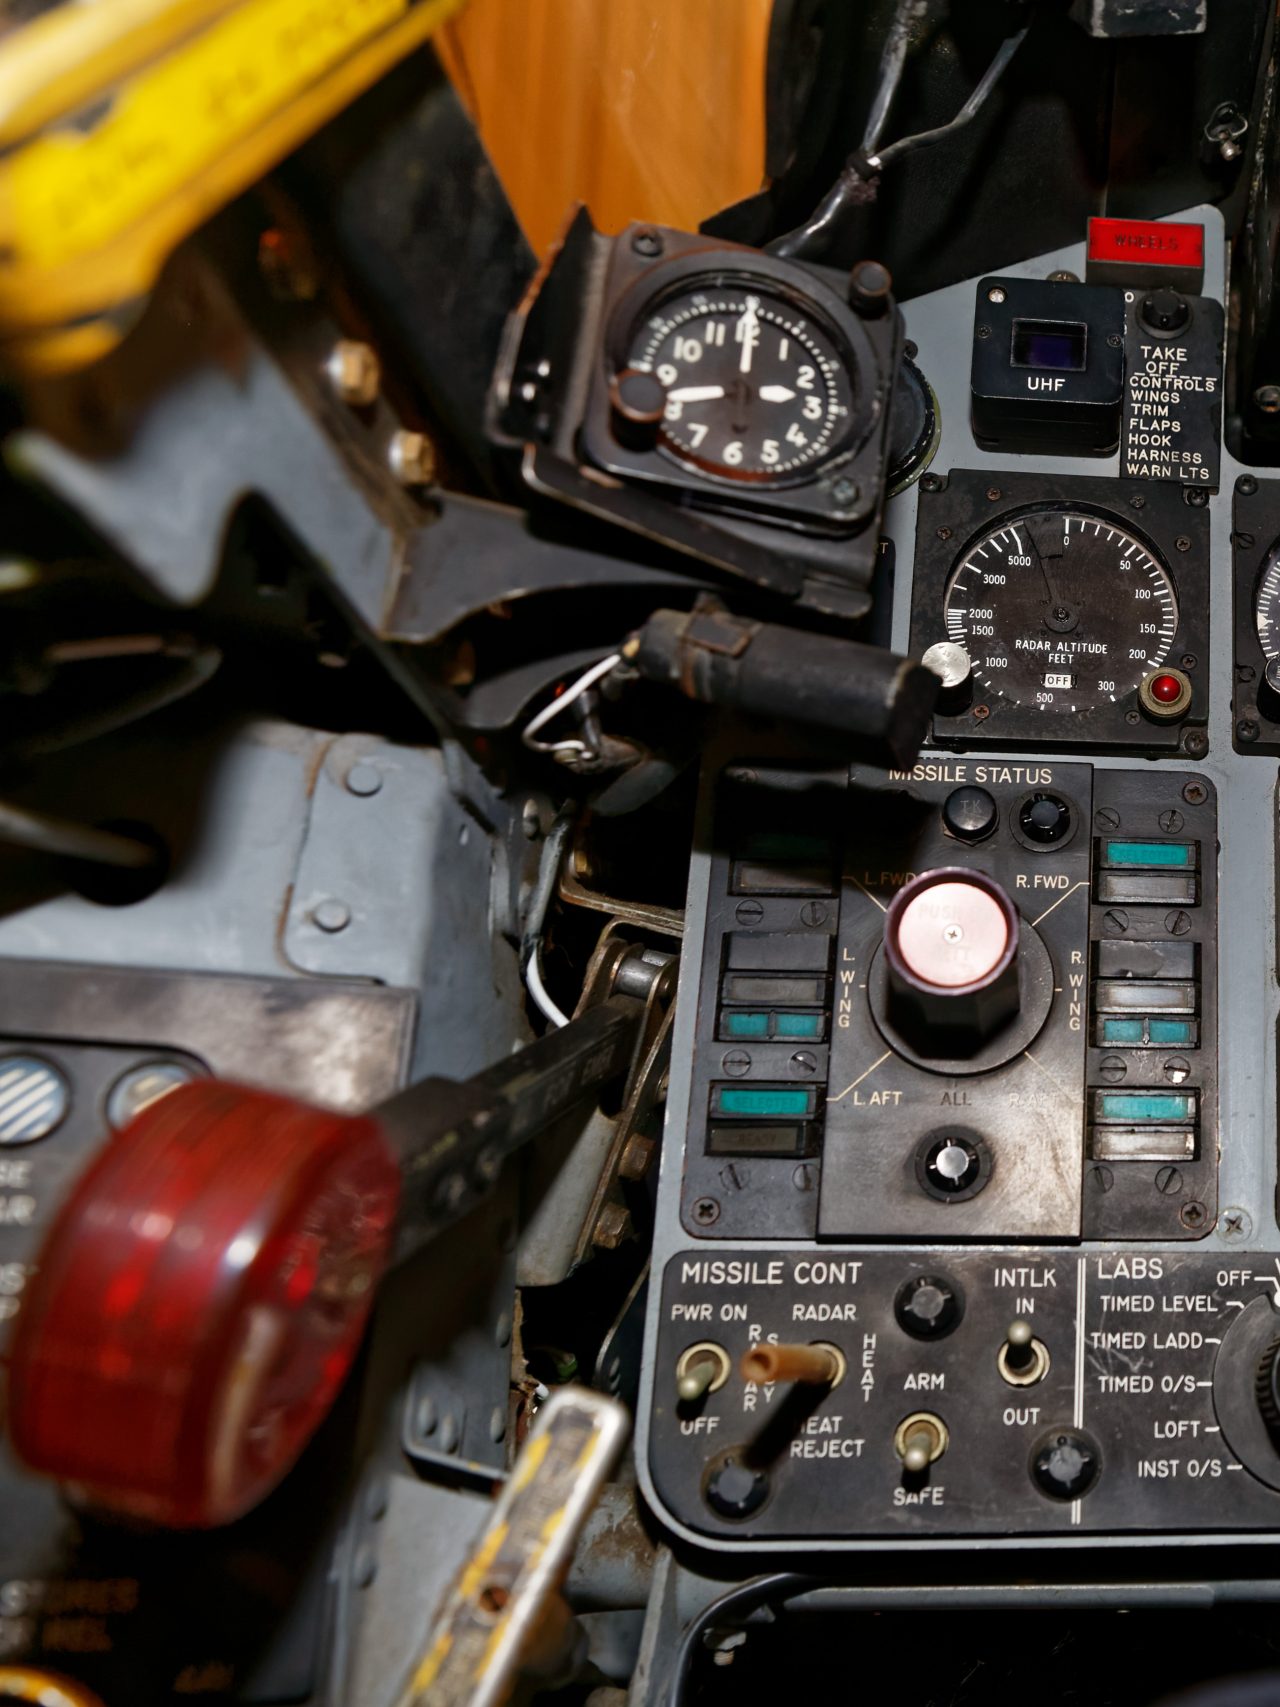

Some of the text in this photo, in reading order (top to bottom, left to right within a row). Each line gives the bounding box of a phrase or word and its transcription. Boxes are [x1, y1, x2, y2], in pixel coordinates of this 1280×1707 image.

[1114, 234, 1179, 251] WHEELS
[704, 320, 726, 347] 11
[673, 336, 703, 363] 10
[1140, 345, 1187, 362] TAKE
[1145, 361, 1180, 374] OFF
[796, 365, 815, 390] 2
[1027, 376, 1066, 392] UHF
[1129, 376, 1215, 392] CONTROLS
[1131, 389, 1180, 404] WINGS
[1131, 403, 1169, 417] TRIM
[1129, 418, 1181, 433] FLAPS
[1128, 433, 1172, 448] HOOK
[760, 439, 780, 464] 5
[1128, 447, 1202, 464] HARNESS
[1126, 462, 1210, 480] WARN LTS
[1007, 555, 1031, 567] 5000
[1119, 560, 1131, 570] 50
[983, 574, 1006, 585] 3000
[1134, 589, 1151, 599] 100
[969, 608, 993, 619] 2000
[971, 625, 994, 636] 1500
[1139, 623, 1156, 634] 150
[1015, 639, 1108, 654] RADAR ALTITUDE
[1128, 649, 1146, 660] 200
[985, 657, 1008, 668] 1000
[1048, 653, 1074, 664] FEET
[1047, 676, 1070, 686] OFF
[889, 765, 1052, 784] MISSILE STATUS
[1016, 875, 1069, 889] R. FWD
[870, 1092, 902, 1105] AFT
[940, 1092, 972, 1106] ALL
[681, 1261, 862, 1285] MISSILE CONT
[994, 1268, 1056, 1288] INTLK
[1098, 1258, 1163, 1281] LABS
[1217, 1270, 1252, 1287] OFF
[671, 1304, 748, 1321] PWR ON
[792, 1303, 857, 1321] RADAR
[1015, 1298, 1035, 1314] IN
[1100, 1296, 1218, 1313] TIMED LEVEL
[1091, 1332, 1203, 1349] TIMED LADD
[860, 1333, 877, 1403] HEAT
[904, 1373, 945, 1391] ARM
[1098, 1375, 1196, 1393] TIMED O/S
[1003, 1408, 1040, 1426] OUT
[680, 1417, 720, 1436] OFF
[1154, 1420, 1200, 1438] LOFT
[790, 1440, 865, 1459] REJECT
[1138, 1459, 1222, 1478] INST O/S
[893, 1487, 945, 1507] SAFE
